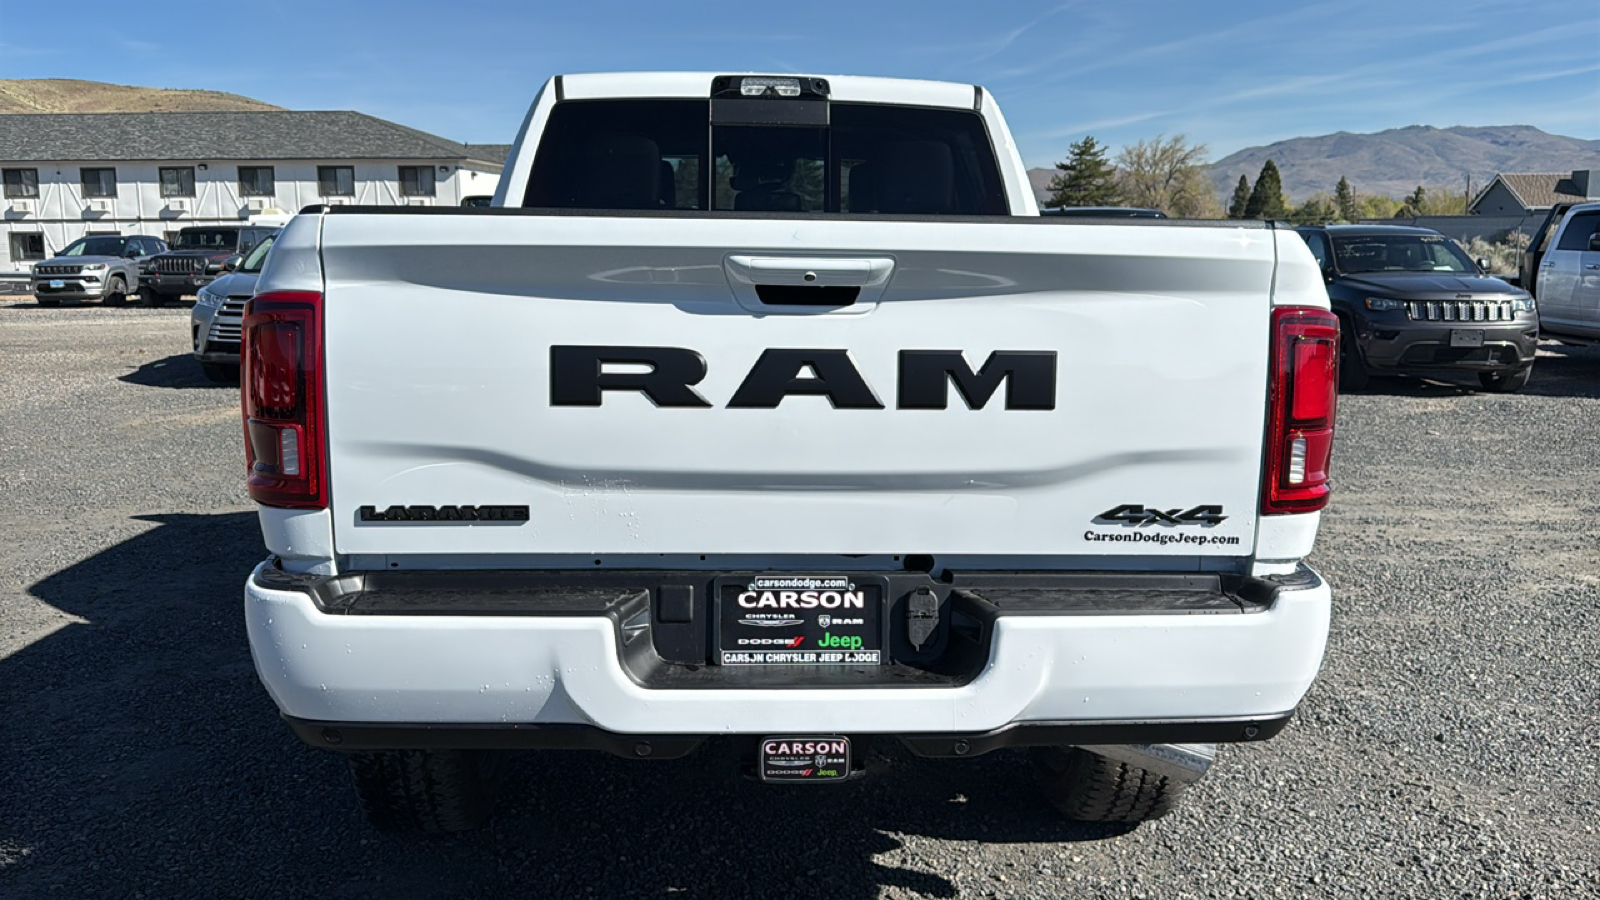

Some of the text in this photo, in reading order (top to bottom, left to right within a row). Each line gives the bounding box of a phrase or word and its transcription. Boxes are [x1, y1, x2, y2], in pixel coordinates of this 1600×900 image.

[549, 345, 1058, 410] RAM
[360, 505, 530, 521] LARAMIE
[1096, 504, 1229, 526] 4x4
[1084, 531, 1240, 545] CarsonDodgeJeep.com
[757, 578, 846, 590] carsondodge.com
[737, 591, 865, 608] CARSON
[831, 617, 864, 625] RAM
[818, 632, 862, 650] Jeep
[766, 653, 816, 662] CHRYSLER
[818, 653, 843, 662] JEEP
[765, 742, 845, 755] CARSON
[817, 768, 837, 776] Jeep
